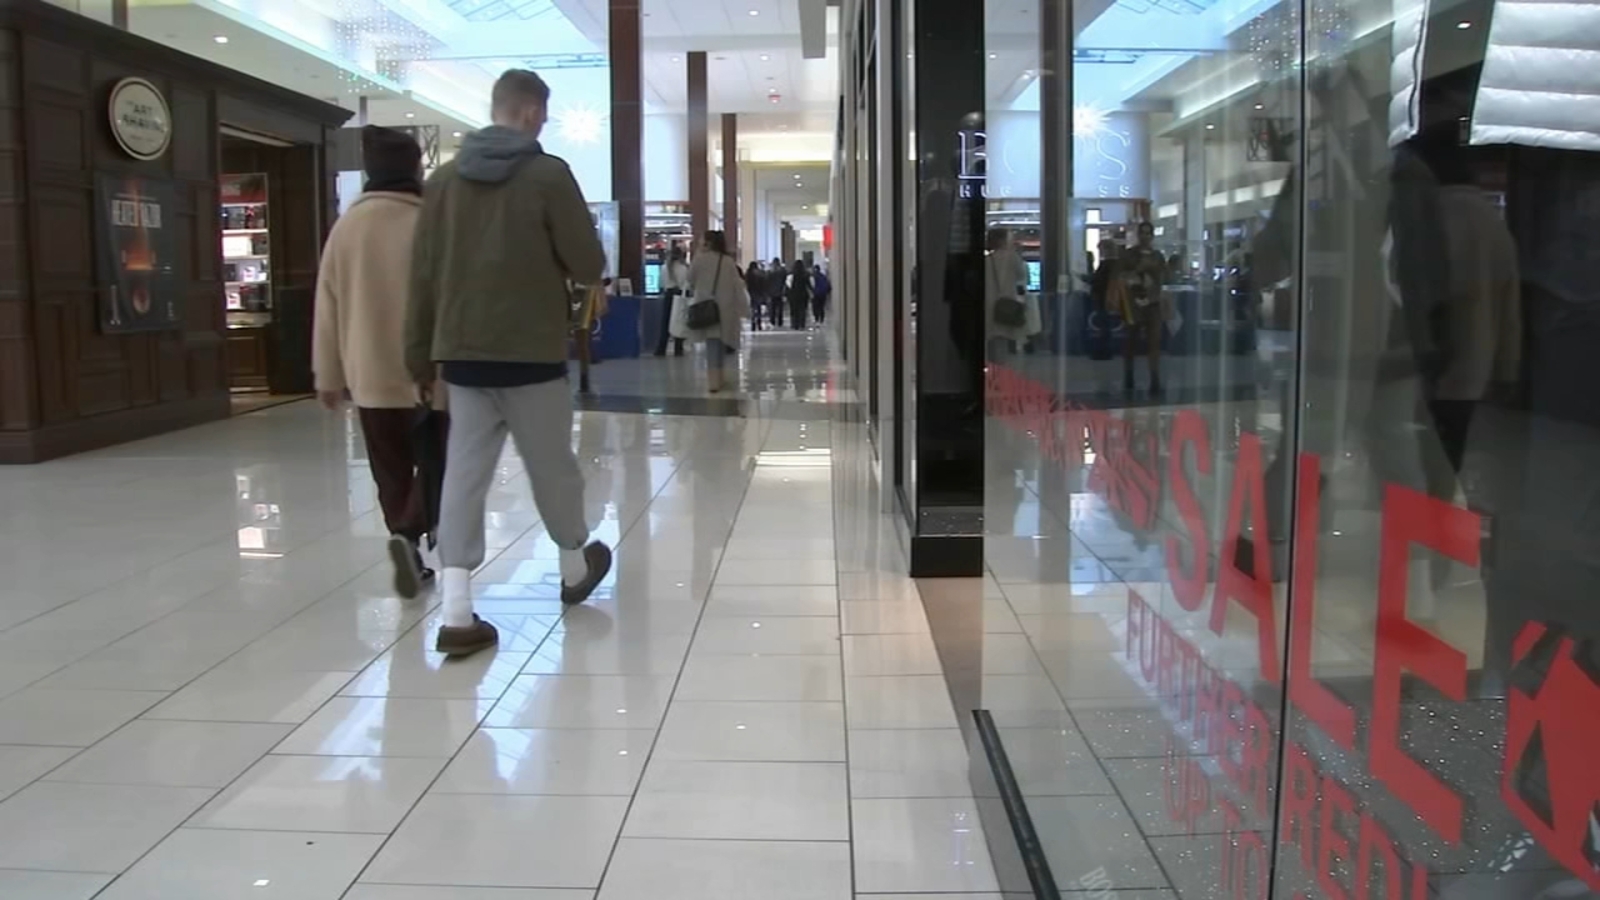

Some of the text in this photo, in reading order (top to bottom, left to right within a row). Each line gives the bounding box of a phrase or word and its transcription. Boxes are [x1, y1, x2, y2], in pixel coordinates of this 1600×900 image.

[1126, 587, 1271, 821] FURTHER
[1166, 410, 1482, 851] SALE
[1163, 735, 1209, 840] UP
